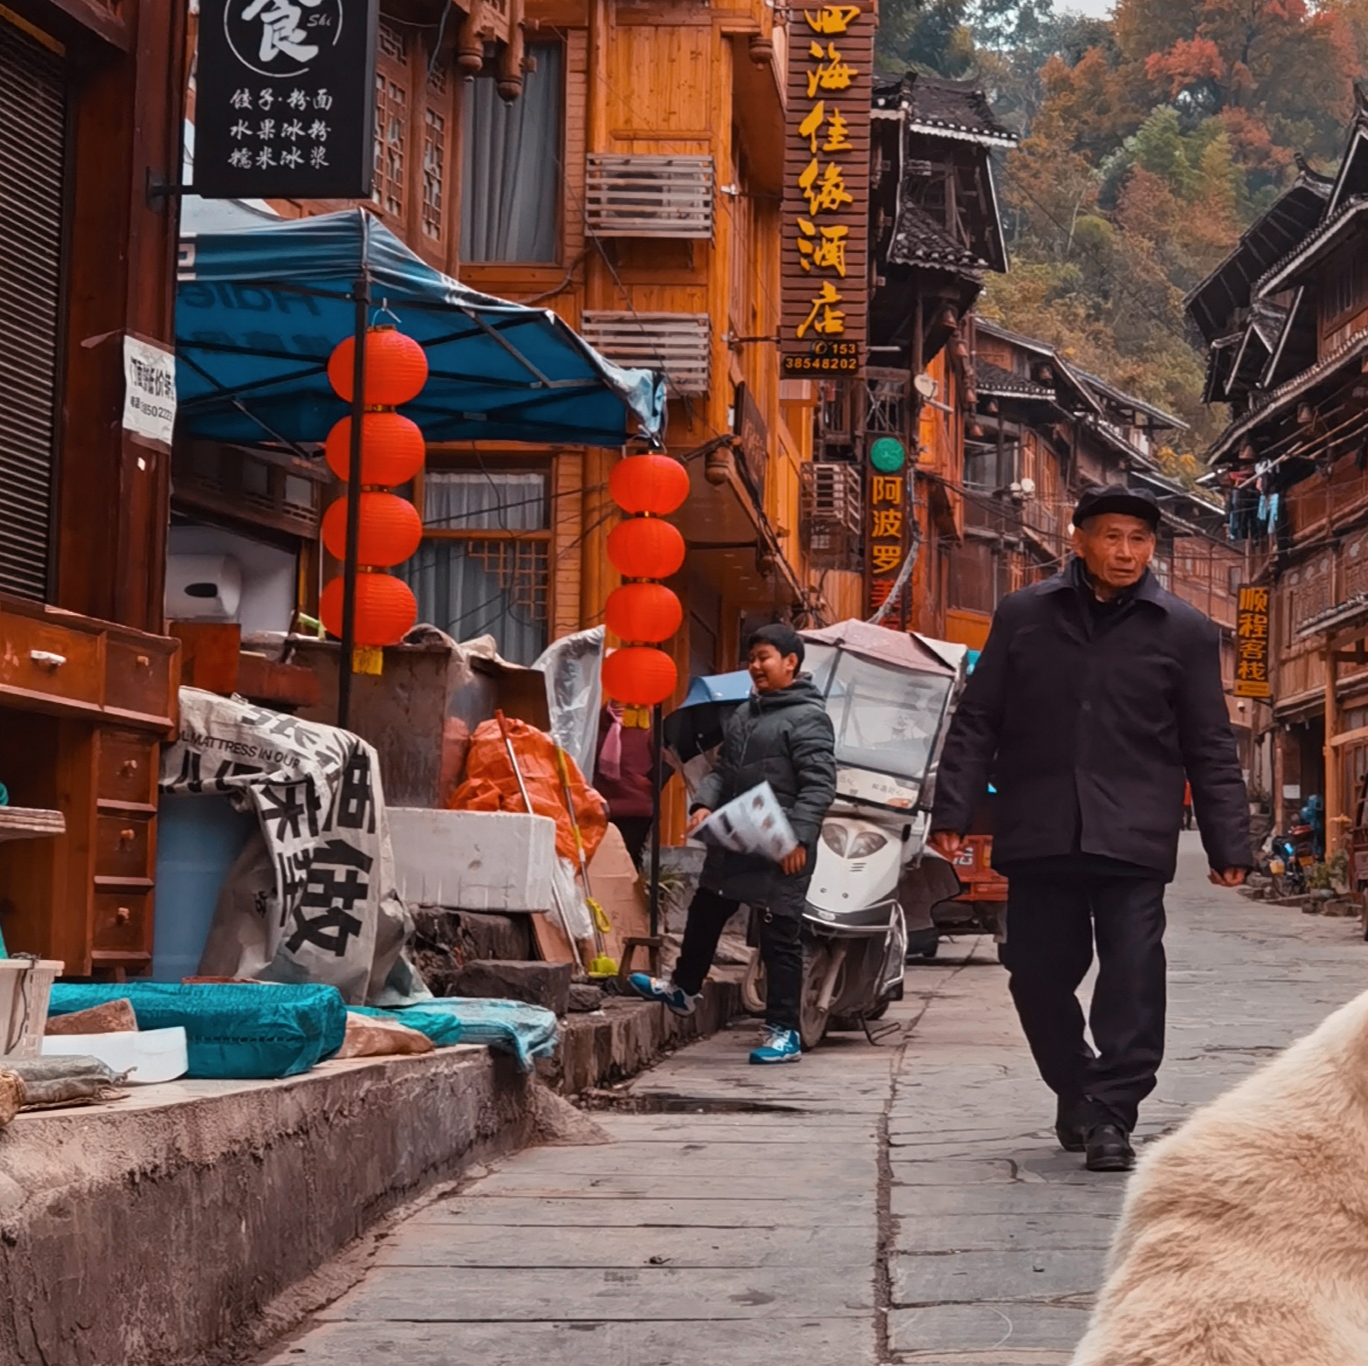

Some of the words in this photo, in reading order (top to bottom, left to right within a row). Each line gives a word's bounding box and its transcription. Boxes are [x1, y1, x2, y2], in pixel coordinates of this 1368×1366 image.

[306, 14, 333, 28] Shi
[229, 119, 332, 142] 水果冰粉
[227, 146, 331, 171] 糯米冰浆
[796, 6, 861, 339] 四海佳缘酒店
[832, 343, 856, 355] 153
[785, 357, 858, 370] 38548202
[1238, 587, 1269, 681] 顺程客栈
[189, 732, 259, 758] MATTRESS
[259, 747, 273, 762] IN
